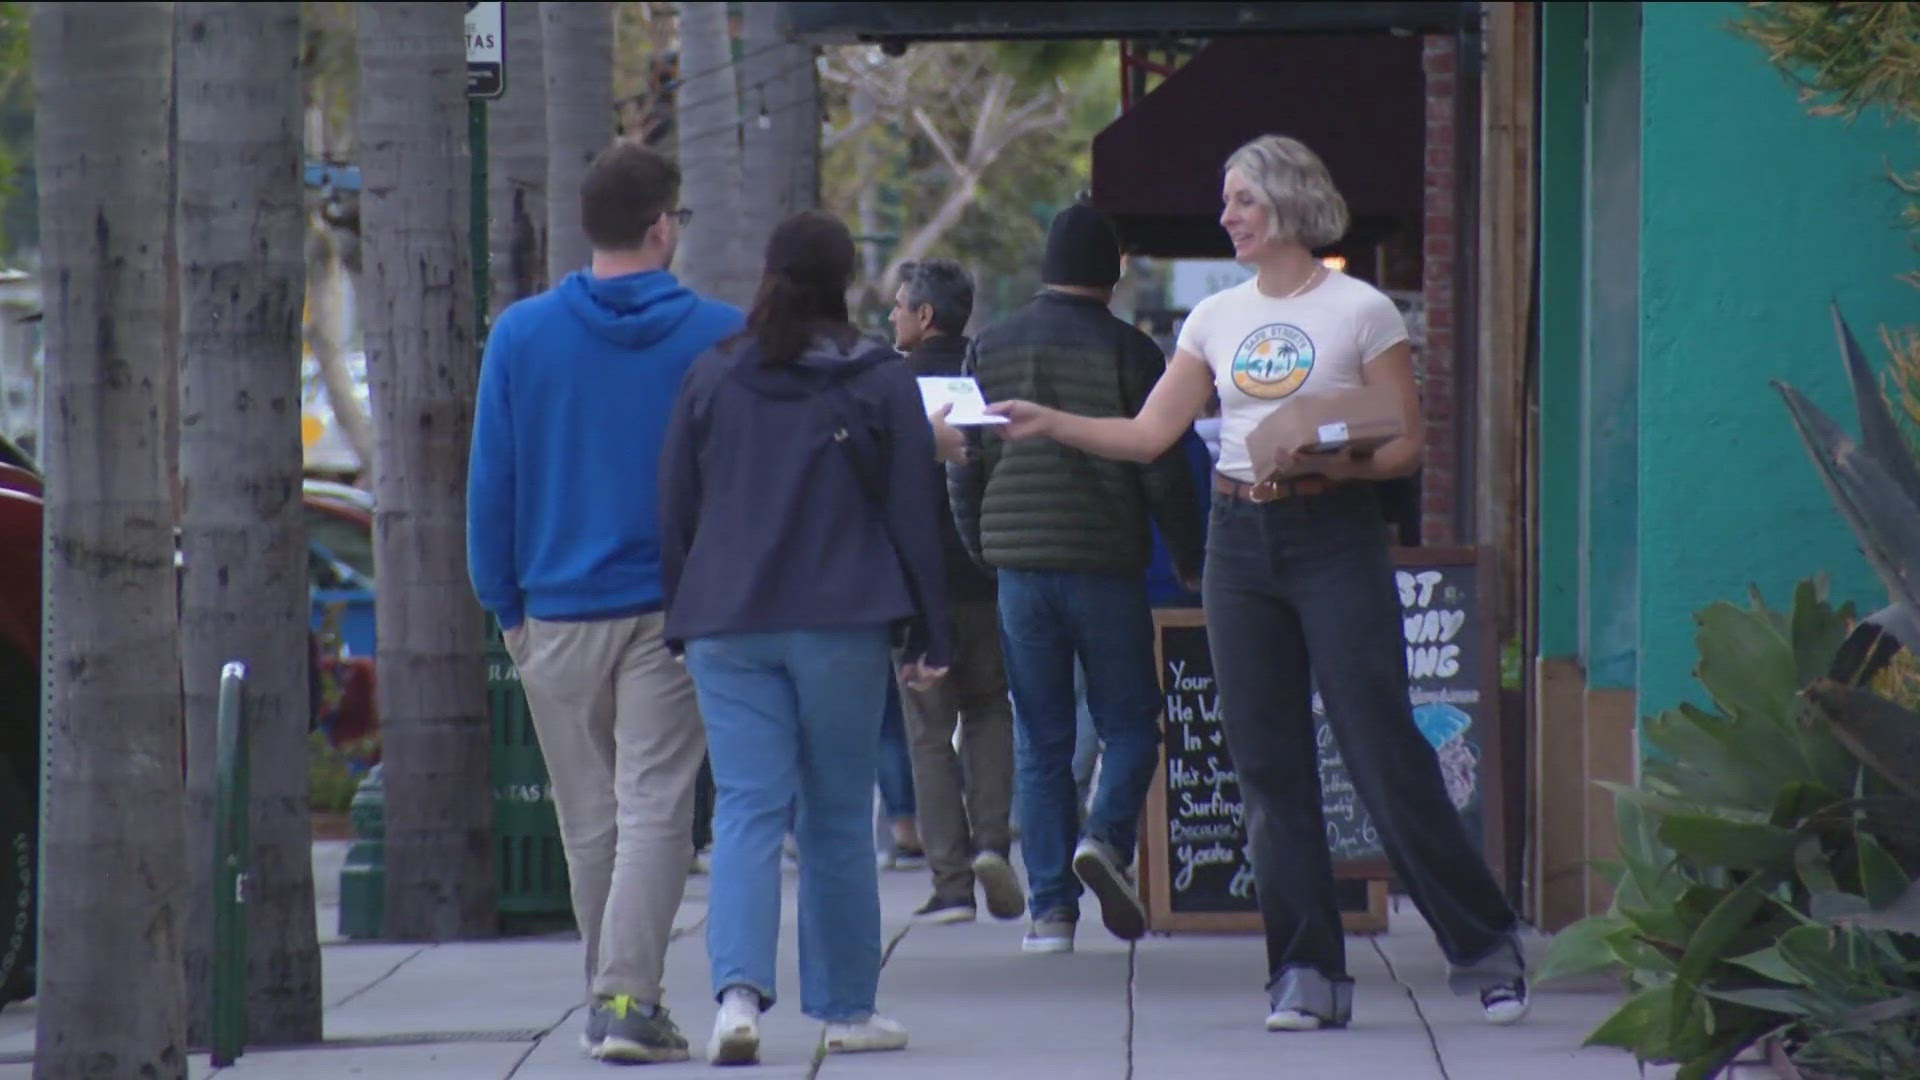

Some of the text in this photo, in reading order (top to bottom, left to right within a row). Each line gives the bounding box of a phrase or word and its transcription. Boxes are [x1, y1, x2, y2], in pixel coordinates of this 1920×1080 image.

[1169, 660, 1213, 690] Your
[1406, 644, 1460, 679] ING
[1167, 693, 1193, 722] He
[1183, 723, 1202, 751] In
[1180, 791, 1244, 827] Surfing
